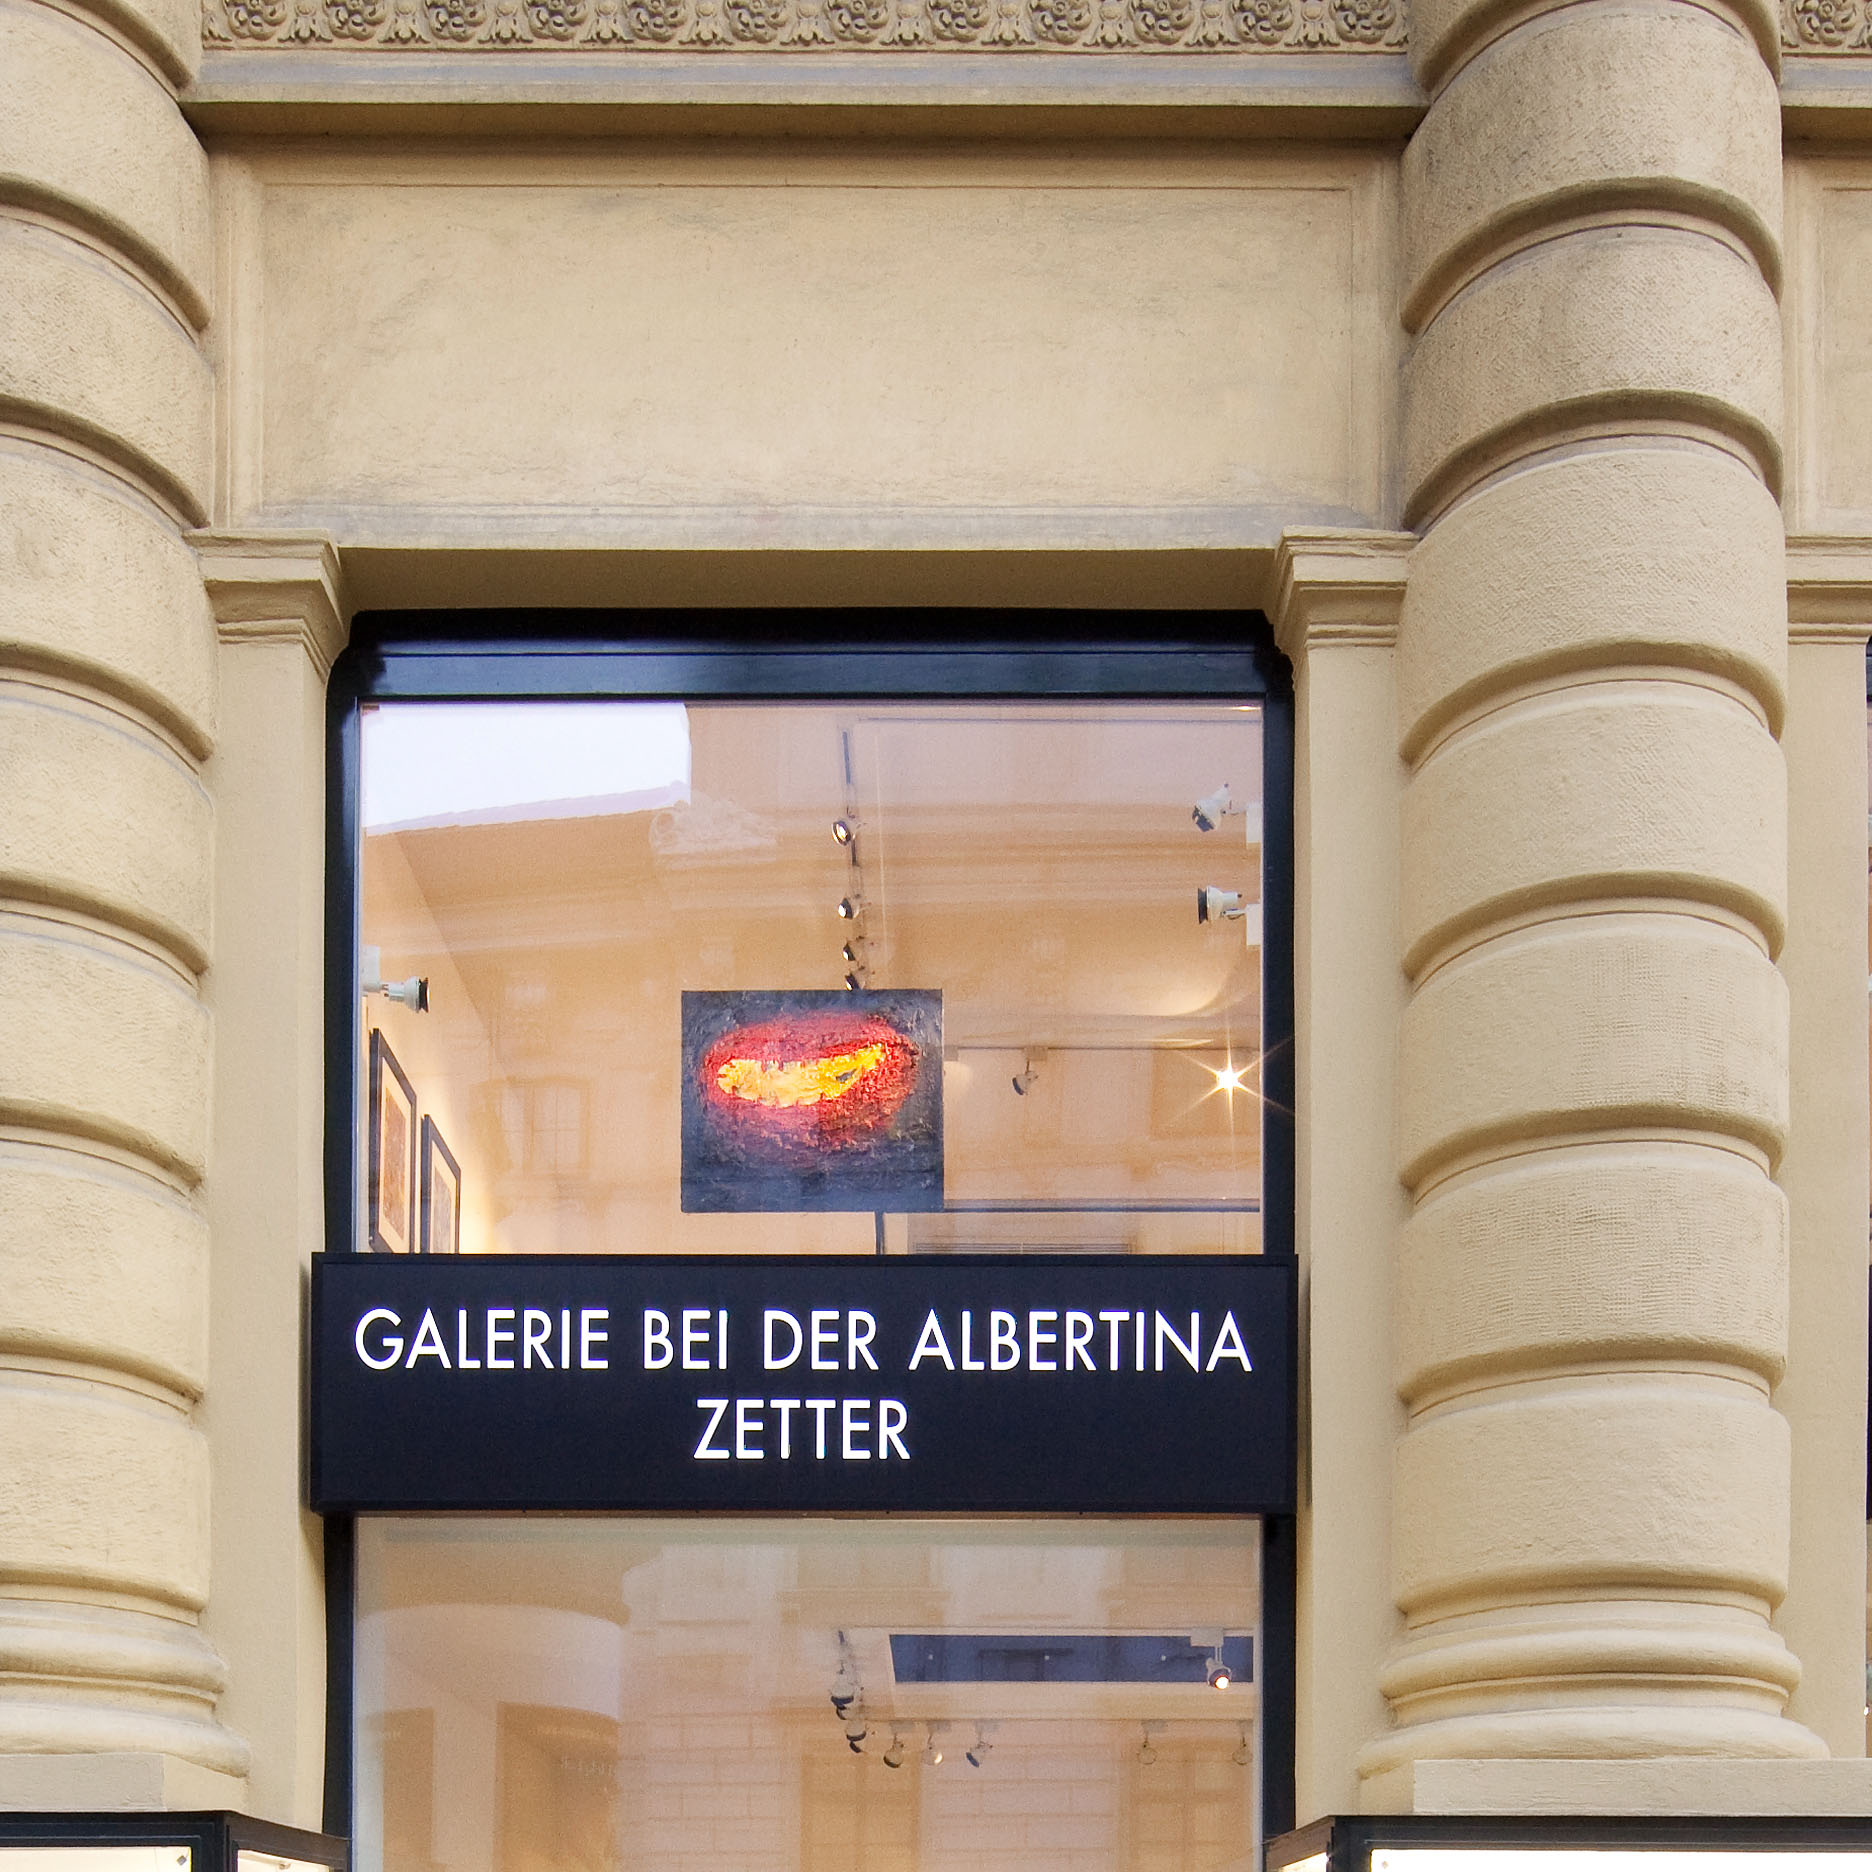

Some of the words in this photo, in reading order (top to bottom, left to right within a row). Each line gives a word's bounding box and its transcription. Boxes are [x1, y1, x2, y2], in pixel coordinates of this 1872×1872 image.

[354, 1307, 611, 1371] GALERIE
[642, 1308, 729, 1371] BEI
[762, 1308, 880, 1371] DER
[907, 1308, 1254, 1375] ALBERTINA
[692, 1398, 912, 1461] ZETTER
